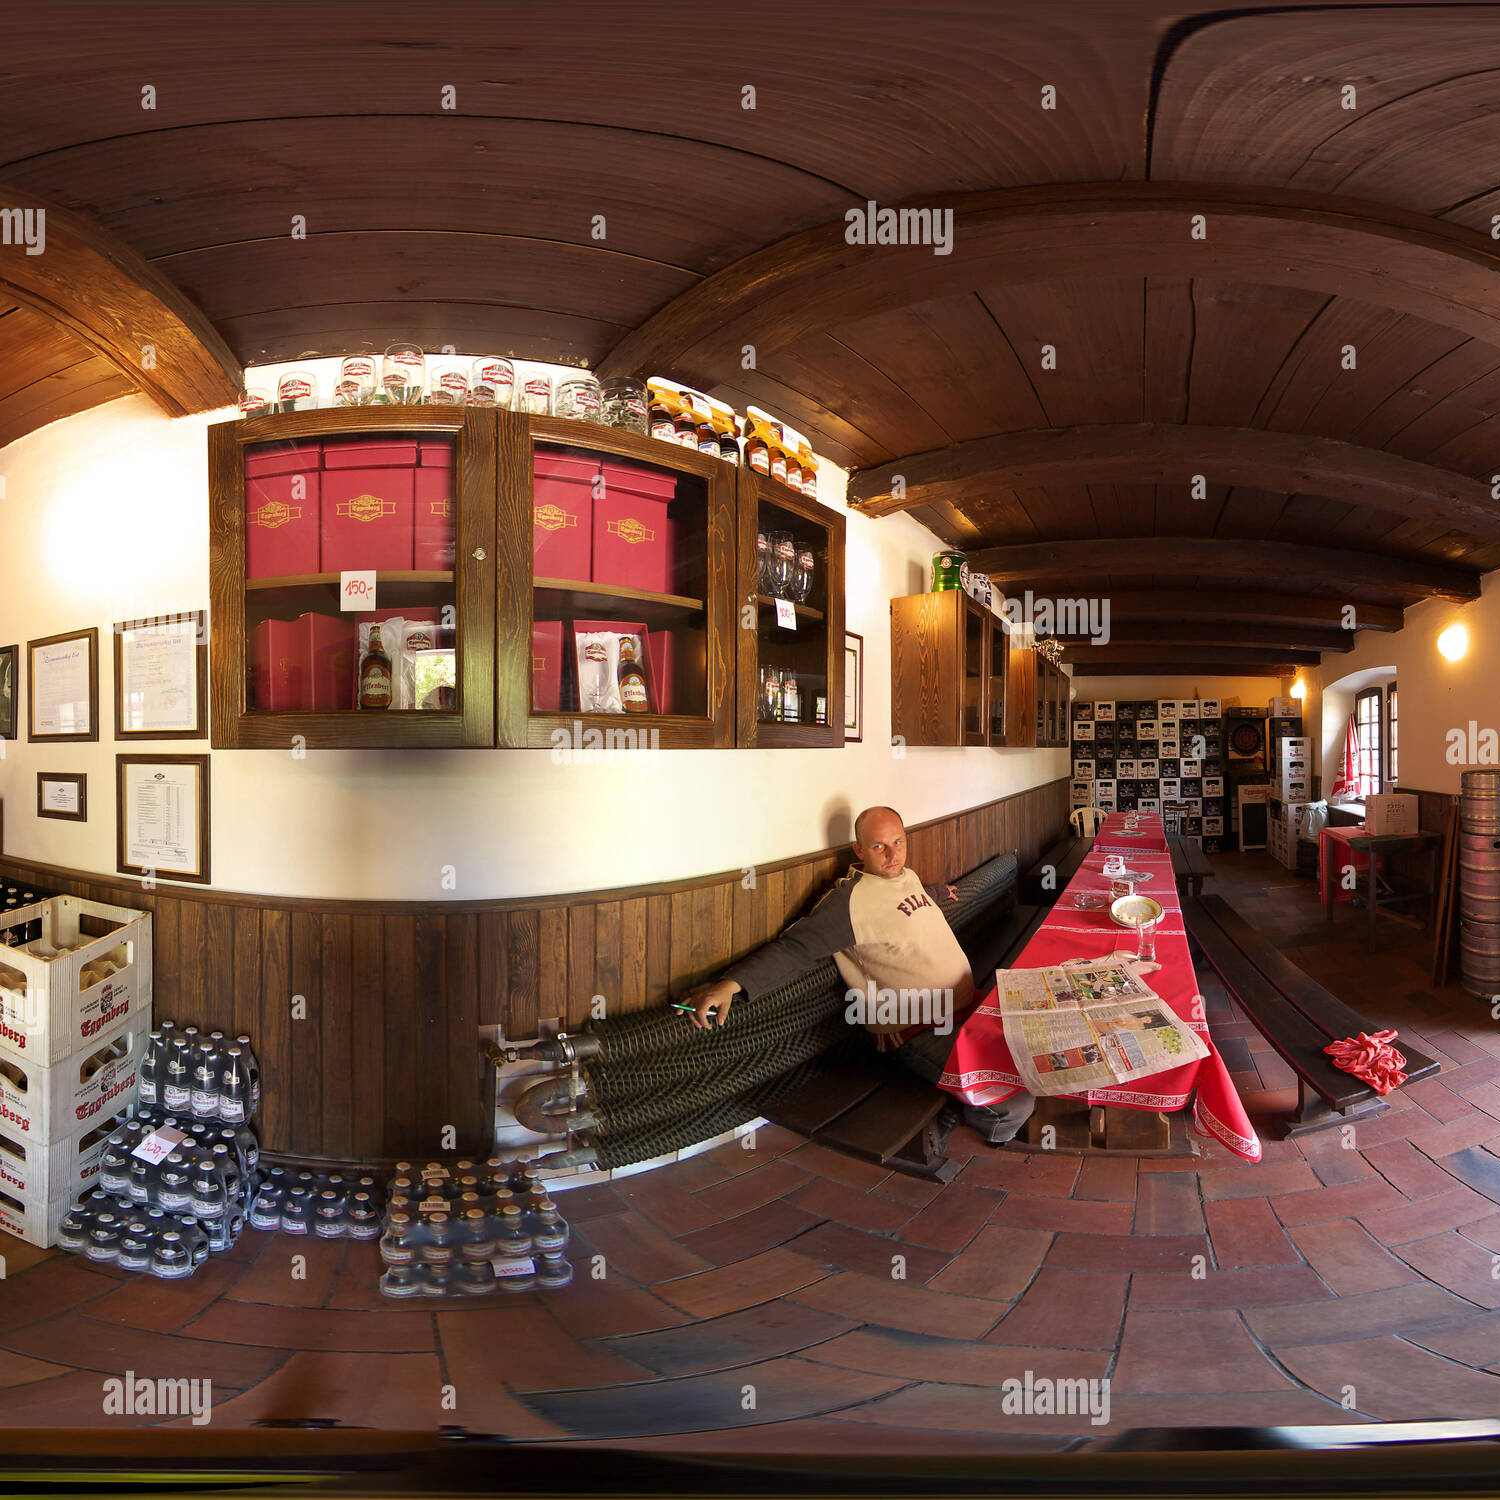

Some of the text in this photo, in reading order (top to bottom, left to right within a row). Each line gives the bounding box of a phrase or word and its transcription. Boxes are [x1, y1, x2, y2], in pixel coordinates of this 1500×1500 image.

[345, 580, 374, 600] 150,-
[896, 894, 932, 917] FILA
[81, 1000, 129, 1037] Eggenberg
[75, 1072, 136, 1120] Eggenberg
